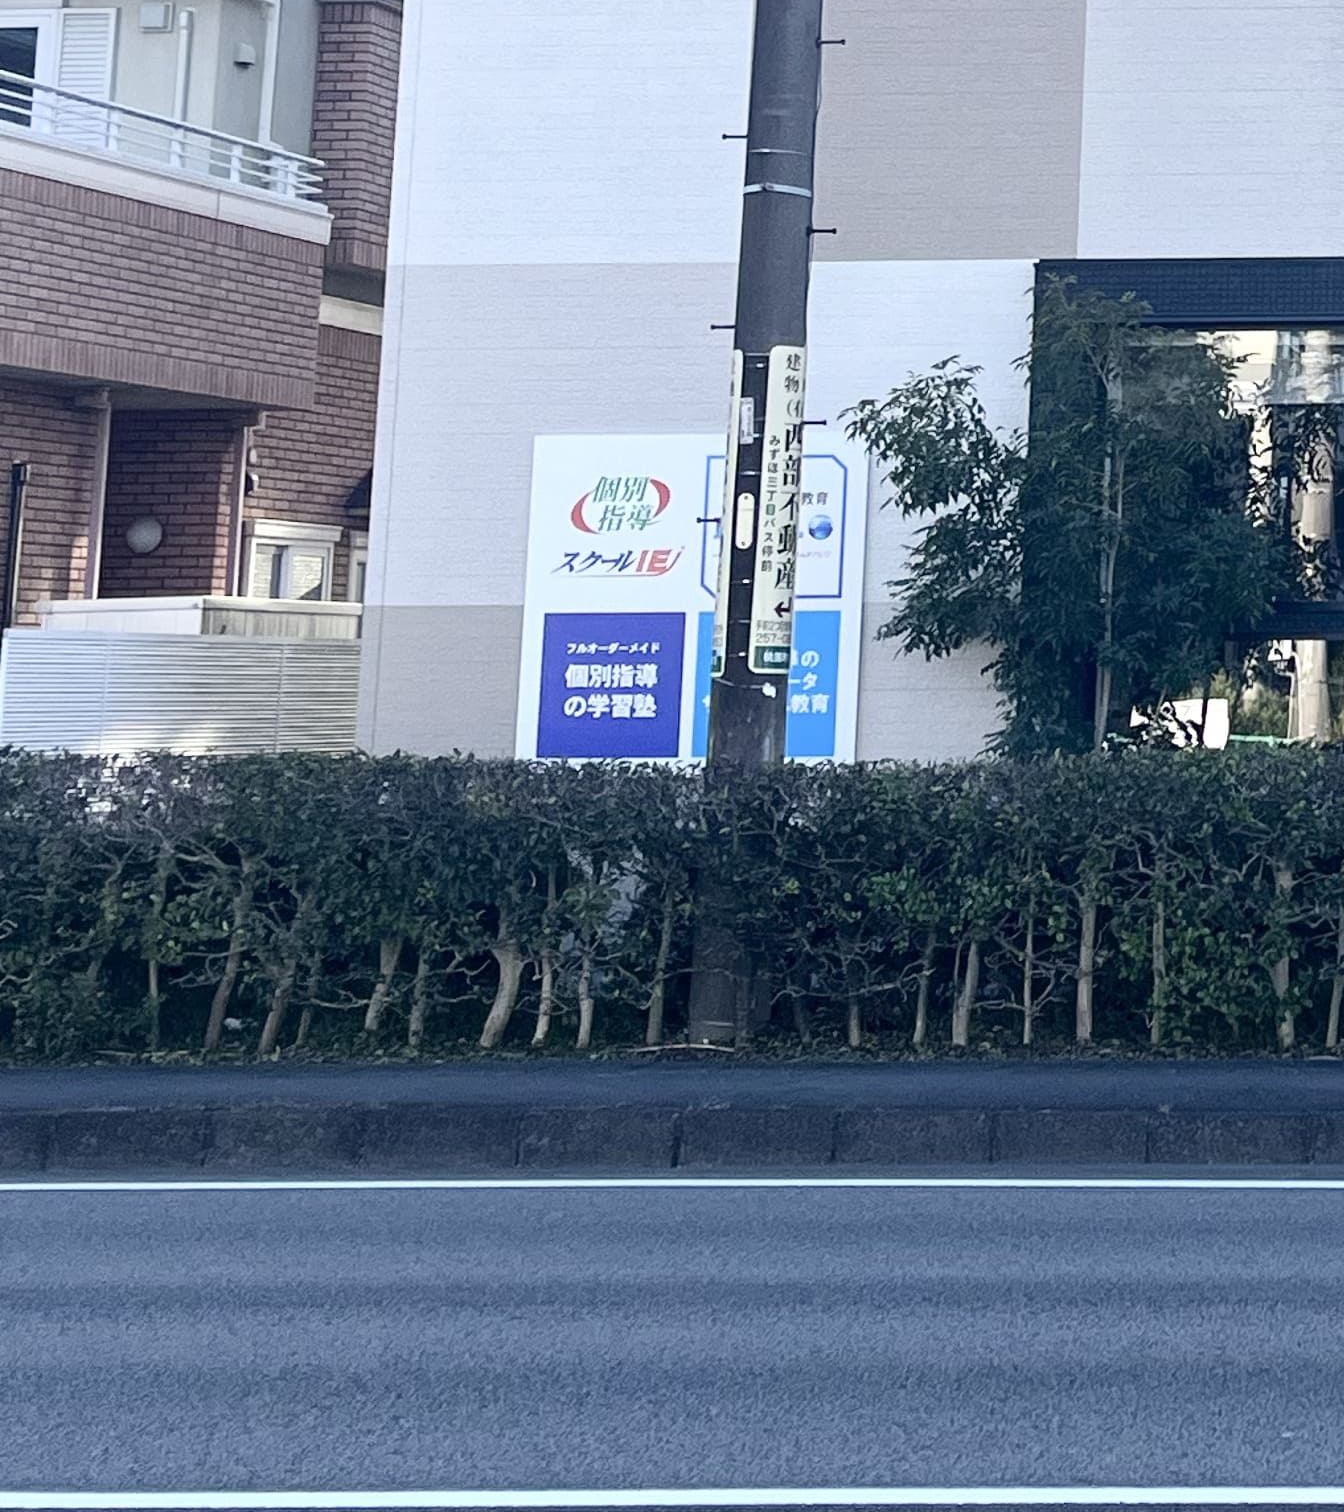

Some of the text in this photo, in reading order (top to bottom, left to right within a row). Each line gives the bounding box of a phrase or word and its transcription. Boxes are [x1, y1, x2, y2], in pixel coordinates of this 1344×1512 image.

[593, 476, 650, 502] 個別
[598, 505, 655, 531] 指導
[551, 549, 672, 574] スクールIE
[567, 642, 660, 654] フルオーダーメイド
[565, 664, 658, 688] 個別指導
[563, 693, 657, 718] の学習塾
